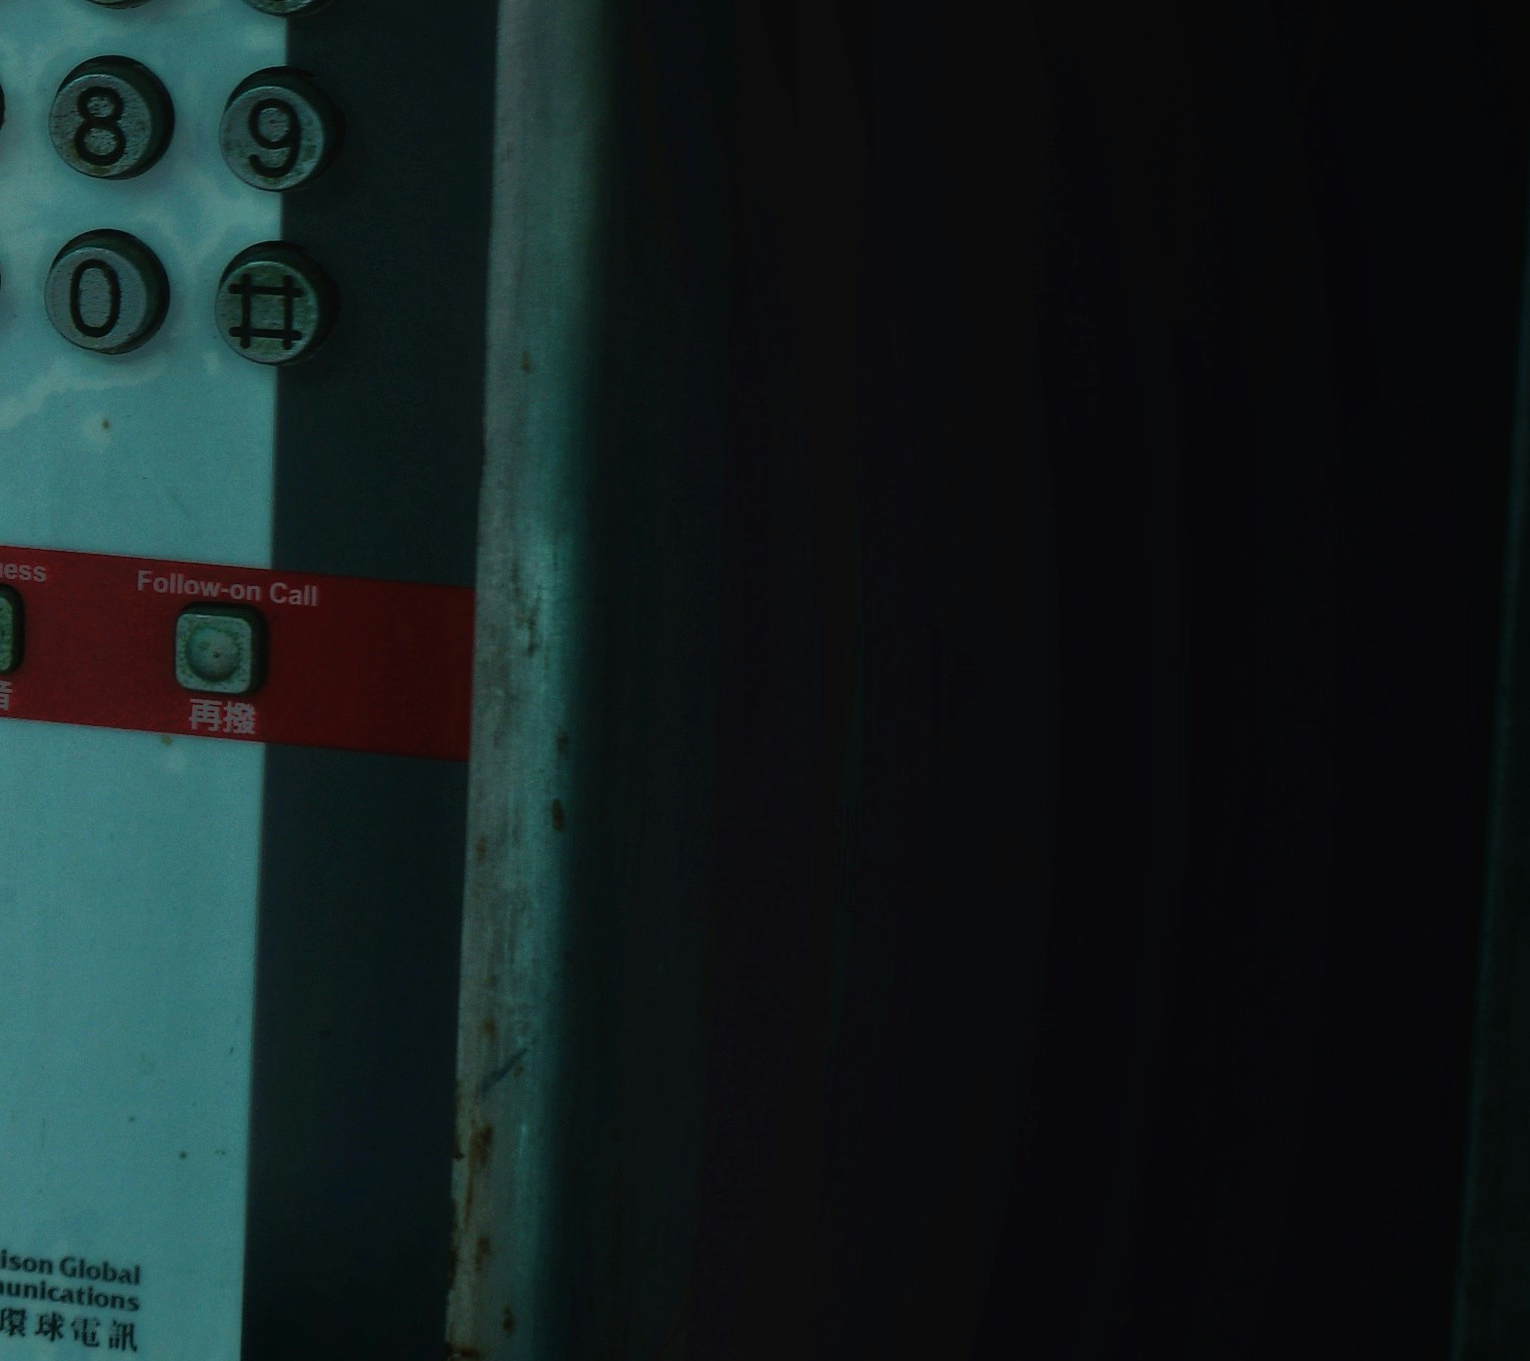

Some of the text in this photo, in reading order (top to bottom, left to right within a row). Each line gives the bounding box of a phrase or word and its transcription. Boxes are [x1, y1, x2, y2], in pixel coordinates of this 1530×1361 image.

[75, 86, 126, 167] 8
[247, 98, 301, 177] 9
[69, 258, 120, 338] 0
[137, 570, 319, 608] Follow-on Call
[187, 698, 257, 736] 再撥
[60, 1257, 141, 1285] Global
